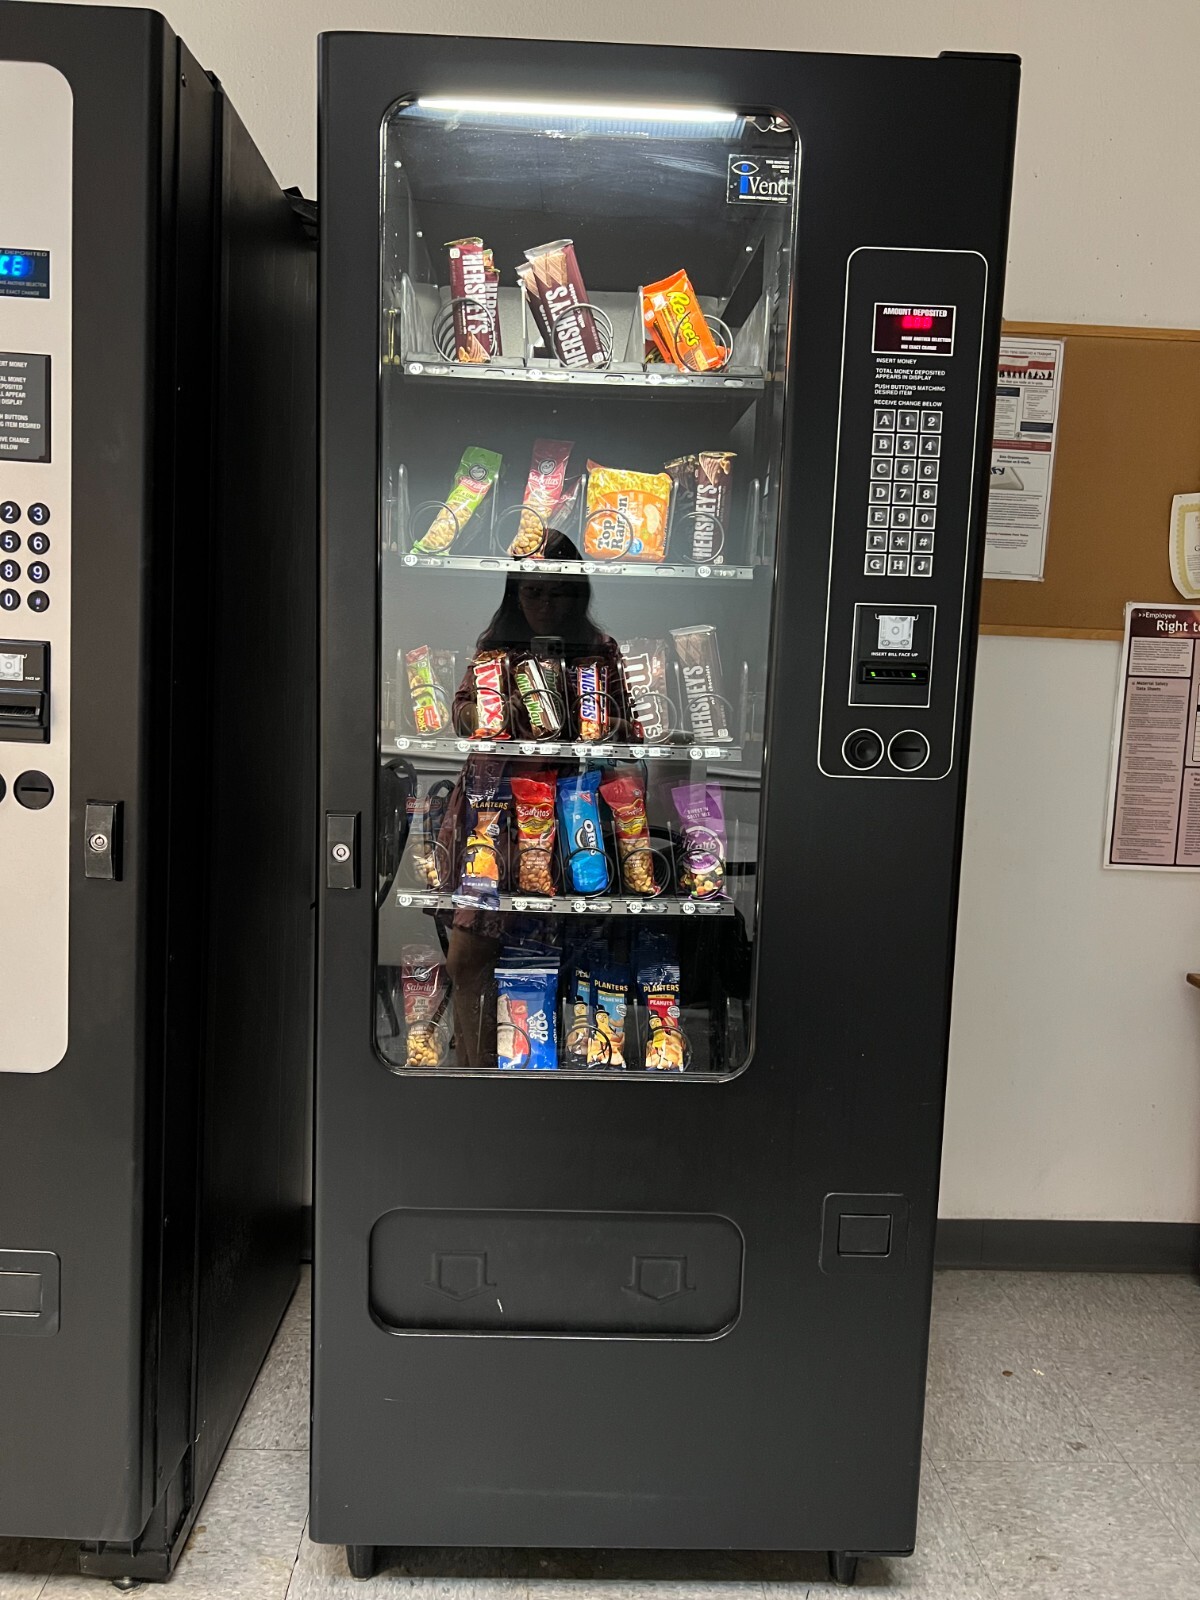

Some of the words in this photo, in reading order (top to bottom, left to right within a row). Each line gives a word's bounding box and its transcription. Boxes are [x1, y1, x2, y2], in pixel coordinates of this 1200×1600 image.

[883, 307, 912, 316] AMOUNT
[912, 308, 948, 318] DEPOSITED
[5, 413, 28, 421] BUTTONS
[879, 416, 890, 425] A
[904, 416, 911, 426] 1
[927, 417, 936, 427] 2
[878, 439, 888, 449] B
[902, 440, 911, 450] 3
[925, 441, 933, 451] 4
[876, 463, 887, 474] C
[901, 464, 909, 474] 5
[924, 465, 932, 475] 6
[875, 487, 886, 498] D
[899, 489, 907, 499] 7
[922, 490, 931, 499] 8
[4, 505, 13, 519] 2
[33, 506, 43, 521] 3
[873, 512, 883, 522] E
[897, 513, 906, 523] 9
[921, 514, 929, 523] 0
[597, 519, 616, 549] Top
[4, 535, 13, 549] 5
[33, 536, 43, 550] 6
[872, 536, 882, 546] F
[870, 559, 880, 570] G
[892, 560, 903, 570] H
[917, 561, 926, 571] J
[4, 564, 13, 578] 8
[33, 565, 43, 580] 9
[4, 593, 13, 607] 0
[1145, 612, 1177, 620] Employee
[1156, 620, 1189, 634] Right
[474, 664, 504, 725] TWIX
[581, 667, 597, 720] SNICKERS
[683, 665, 714, 738] HERSHEY'S
[470, 801, 509, 810] PLANTERS
[406, 983, 435, 992] Sabrita
[594, 979, 629, 992] PLANTERS
[643, 984, 680, 993] PLANTERS
